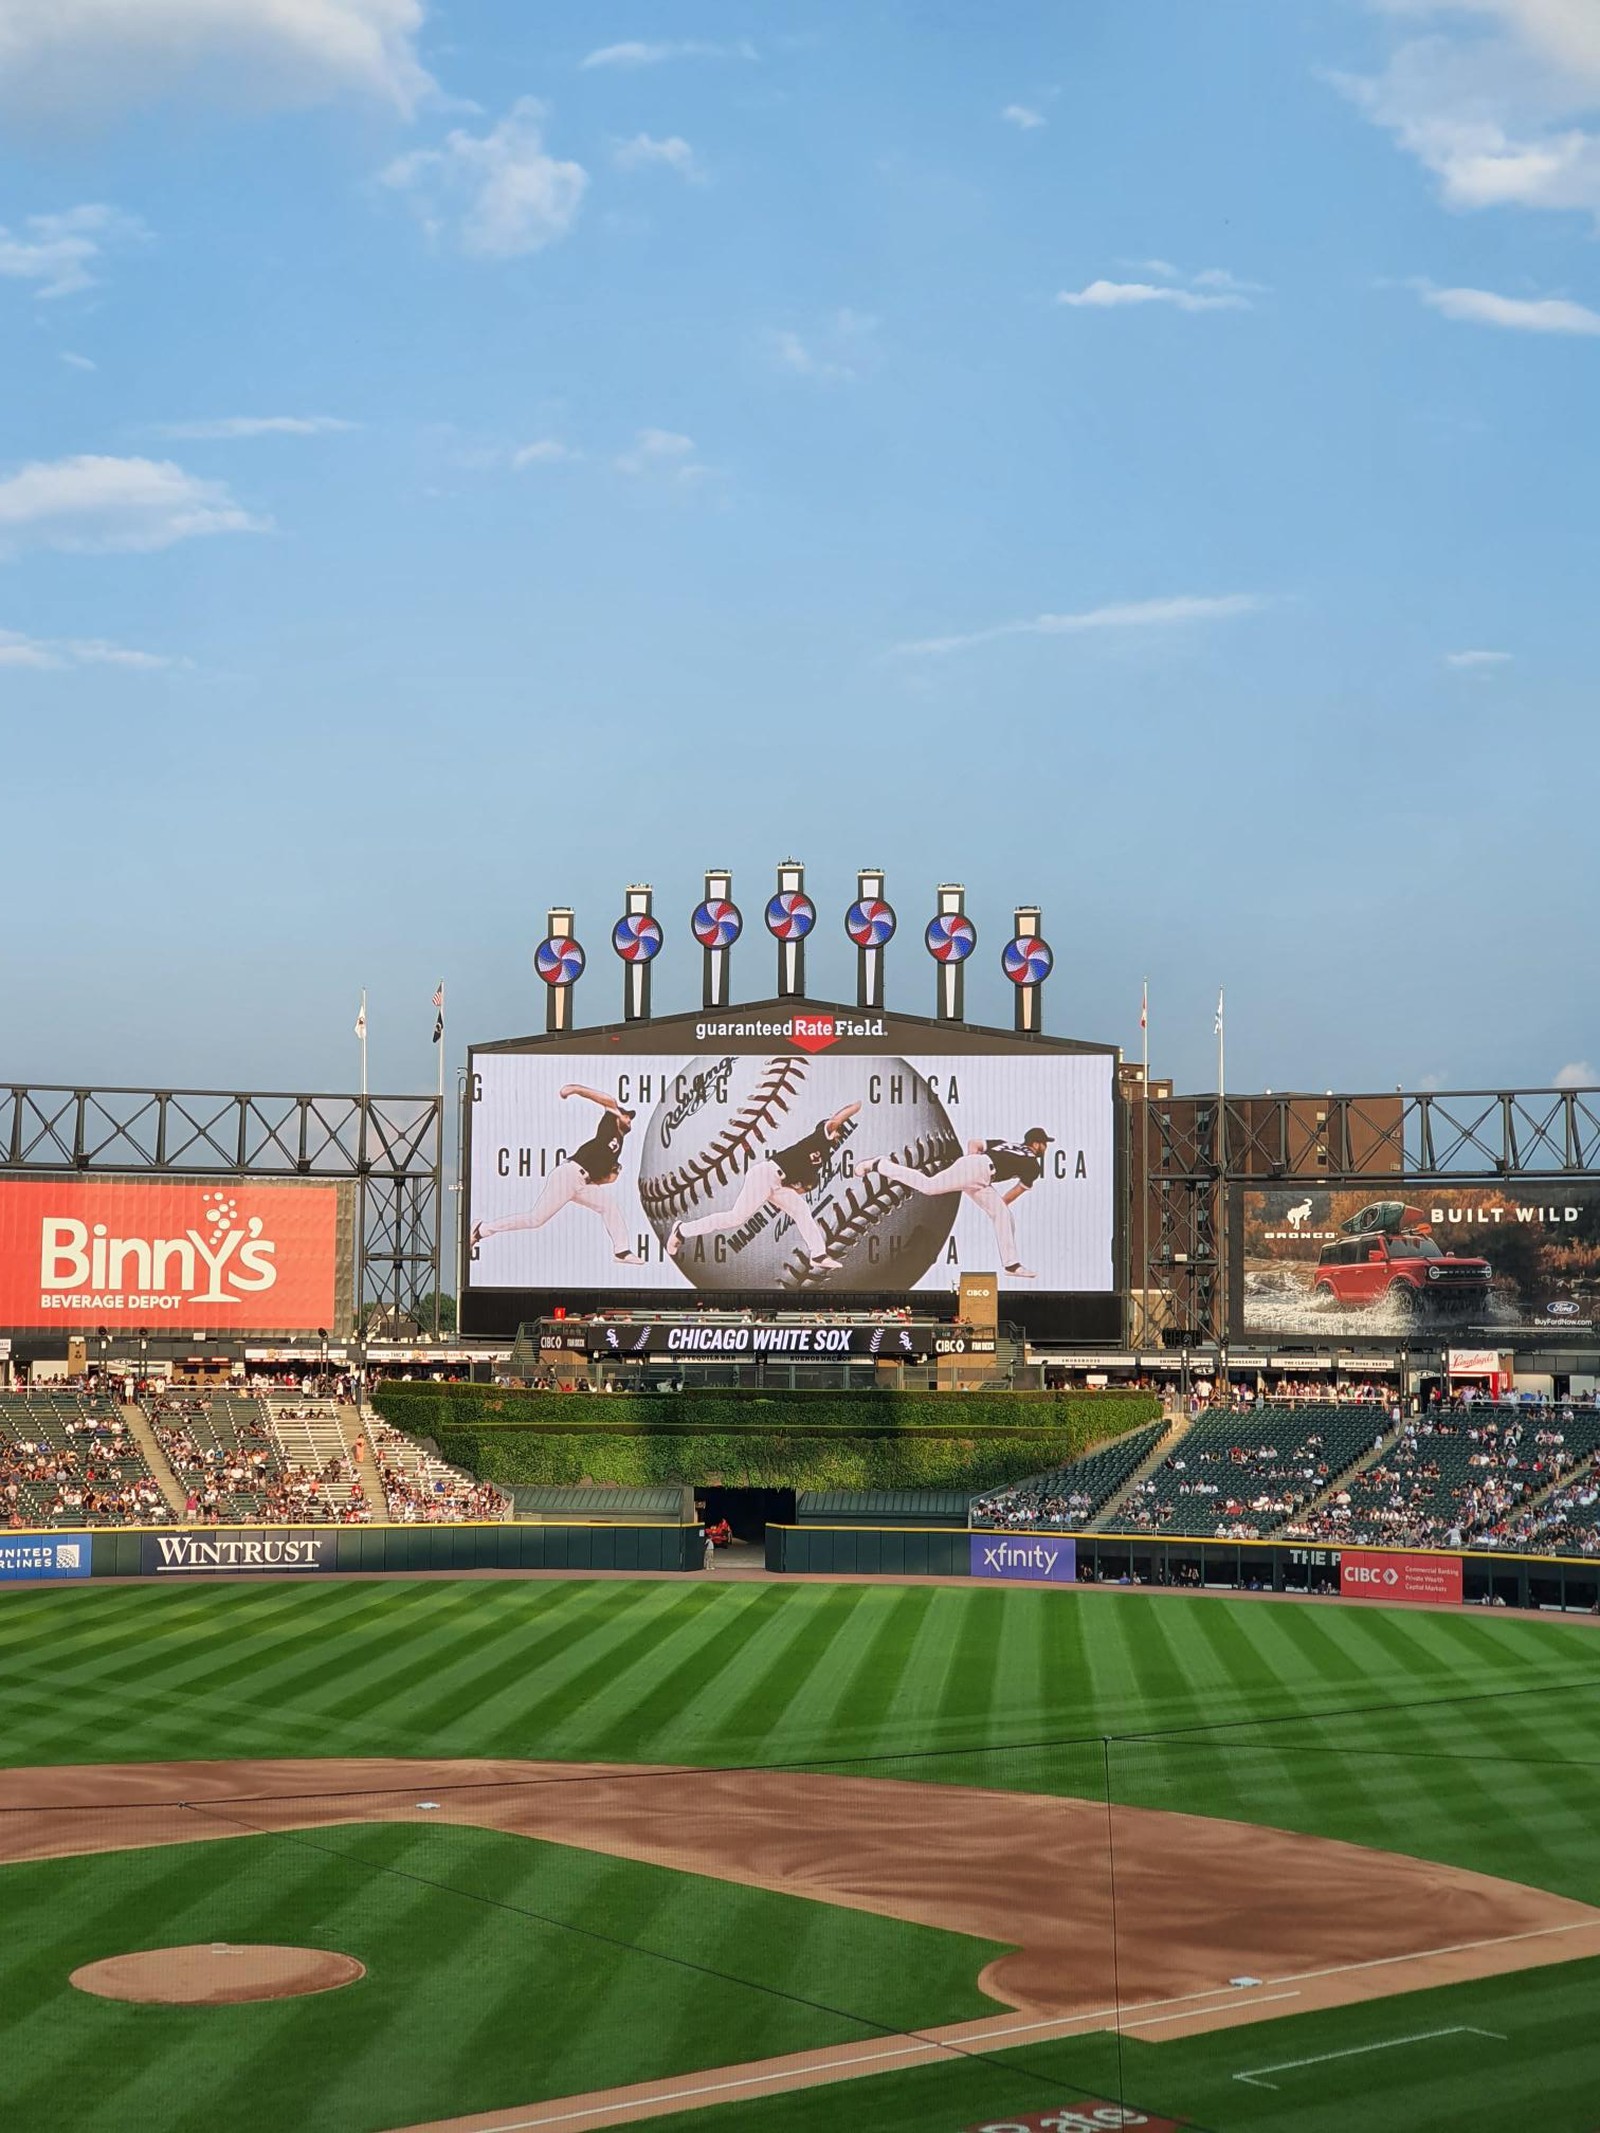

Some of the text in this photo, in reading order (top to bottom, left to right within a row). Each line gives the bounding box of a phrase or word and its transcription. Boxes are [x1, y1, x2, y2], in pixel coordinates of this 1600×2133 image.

[696, 1020, 792, 1039] guaranteed
[795, 1020, 832, 1036] Rate
[1431, 1208, 1504, 1223] BUILT
[41, 1216, 277, 1303] Binny's
[41, 1295, 182, 1309] BEVERAGE DEPOT
[1553, 1303, 1573, 1312] Ford
[668, 1328, 853, 1351] CHICAGO WHITE SOX
[936, 1340, 955, 1352] CIBC
[157, 1537, 321, 1566] WINTRUST
[984, 1542, 1058, 1575] xfinity
[1289, 1549, 1326, 1566] THE
[1344, 1566, 1380, 1583] CIBC
[1405, 1565, 1459, 1577] Commercial Banking
[1405, 1574, 1444, 1584] Private Wealth
[1405, 1583, 1447, 1593] Capital Markets
